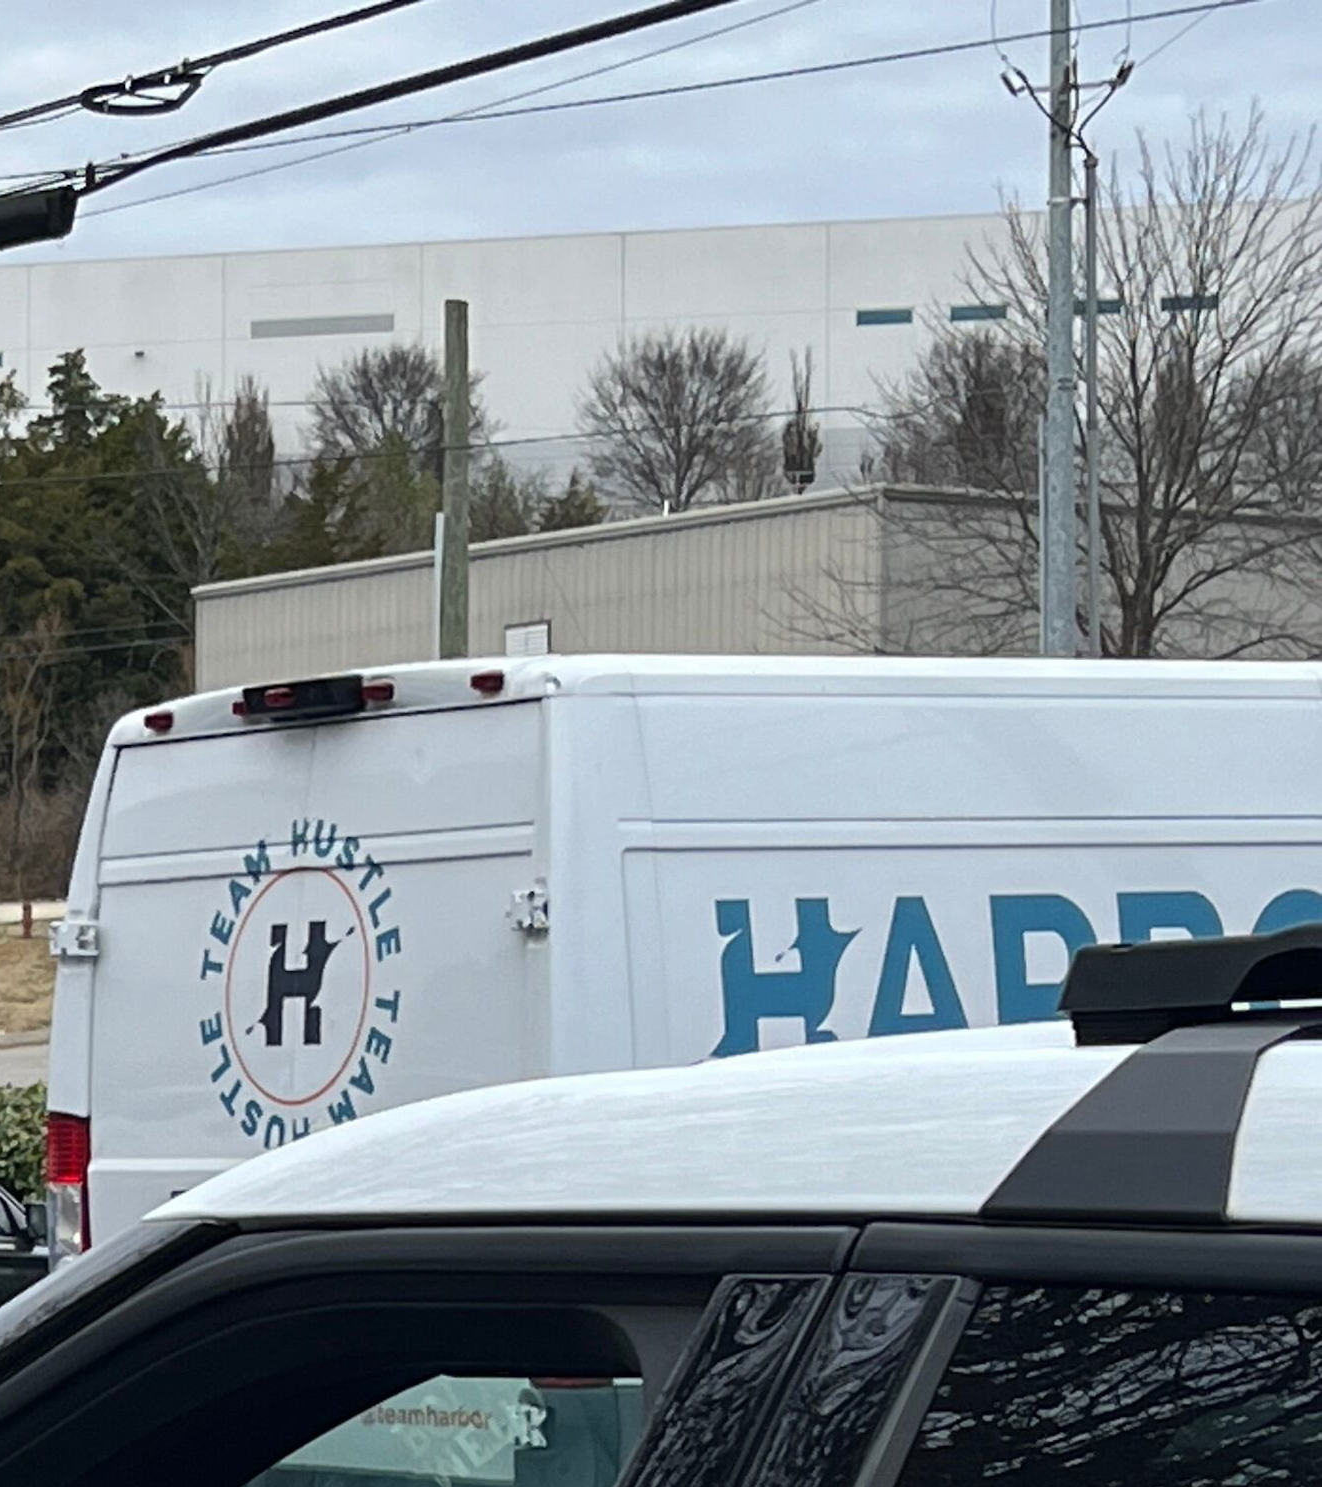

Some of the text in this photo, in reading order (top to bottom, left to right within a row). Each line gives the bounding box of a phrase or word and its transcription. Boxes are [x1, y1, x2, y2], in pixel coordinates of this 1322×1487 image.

[201, 840, 272, 980] TEAM
[291, 819, 402, 962] HUSTLE
[328, 990, 401, 1126] TEAM
